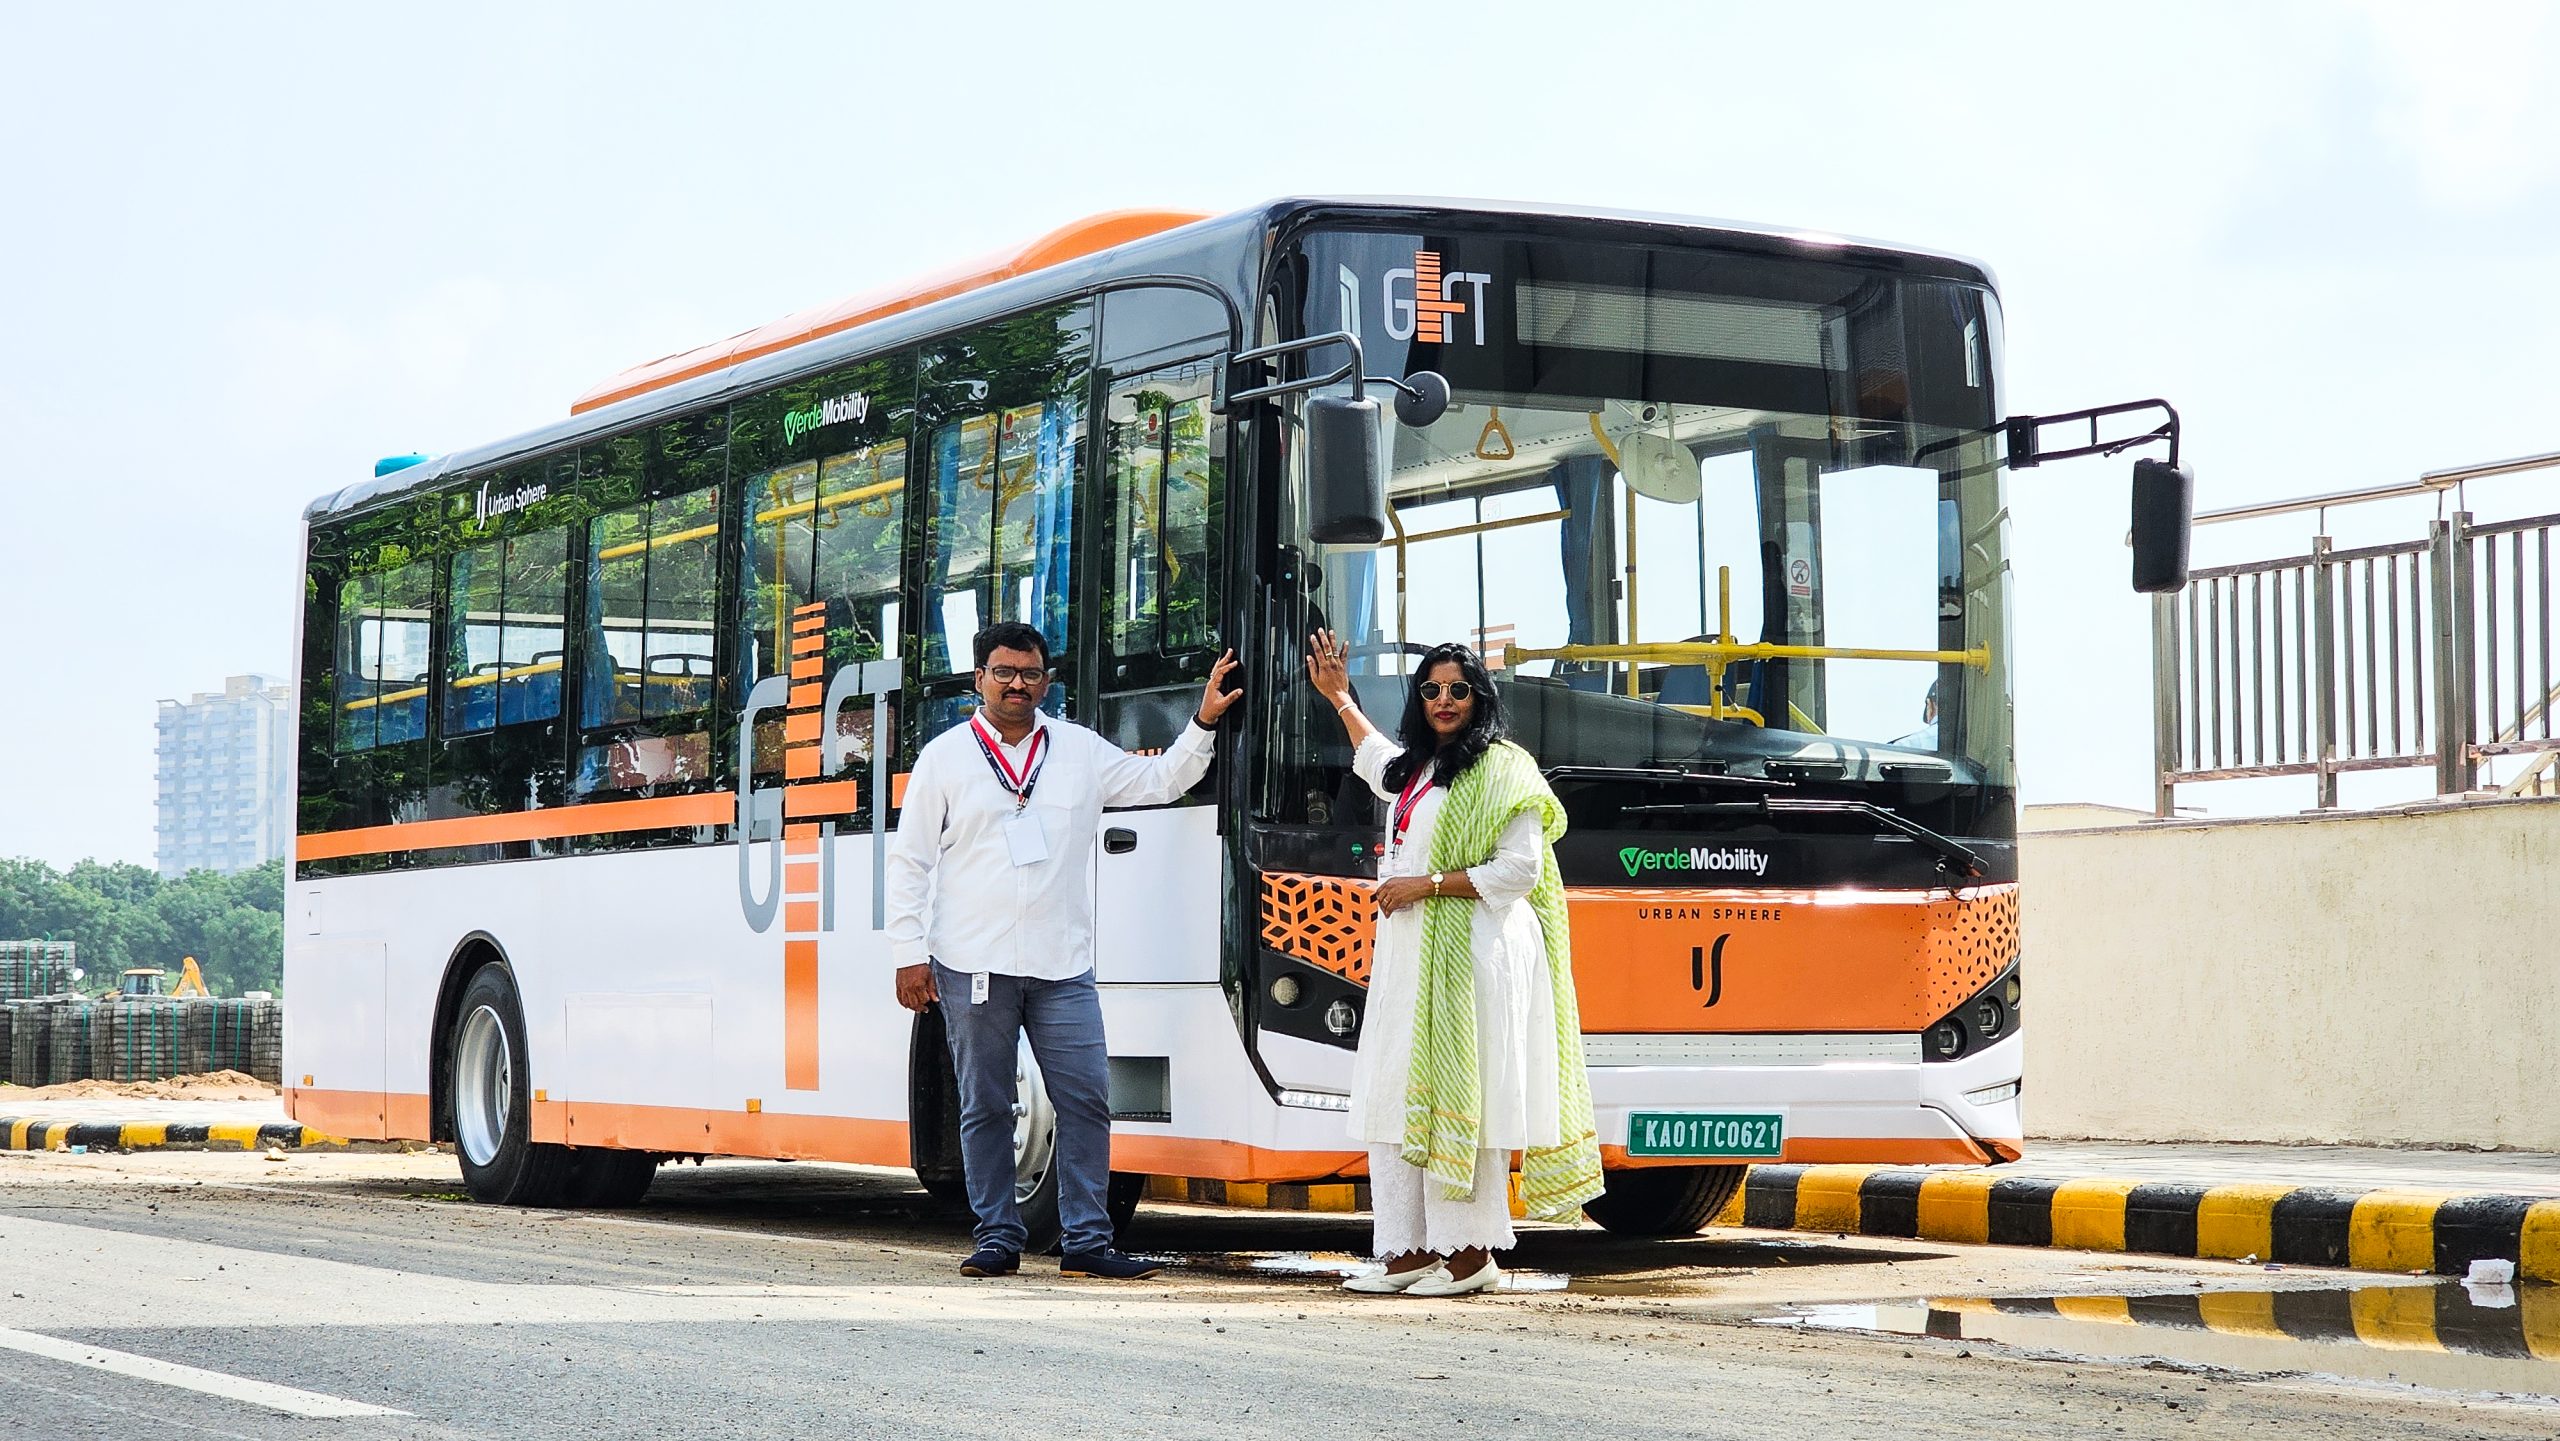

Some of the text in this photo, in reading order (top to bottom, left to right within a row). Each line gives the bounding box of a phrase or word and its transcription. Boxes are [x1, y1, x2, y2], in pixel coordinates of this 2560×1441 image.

[784, 391, 870, 446] VerdeMobility
[488, 483, 547, 517] Urban Sphere
[1619, 847, 1769, 877] VerdeMobility
[1638, 908, 1782, 921] URBAN SPHERE
[1645, 1120, 1779, 1149] KA01TC0621
